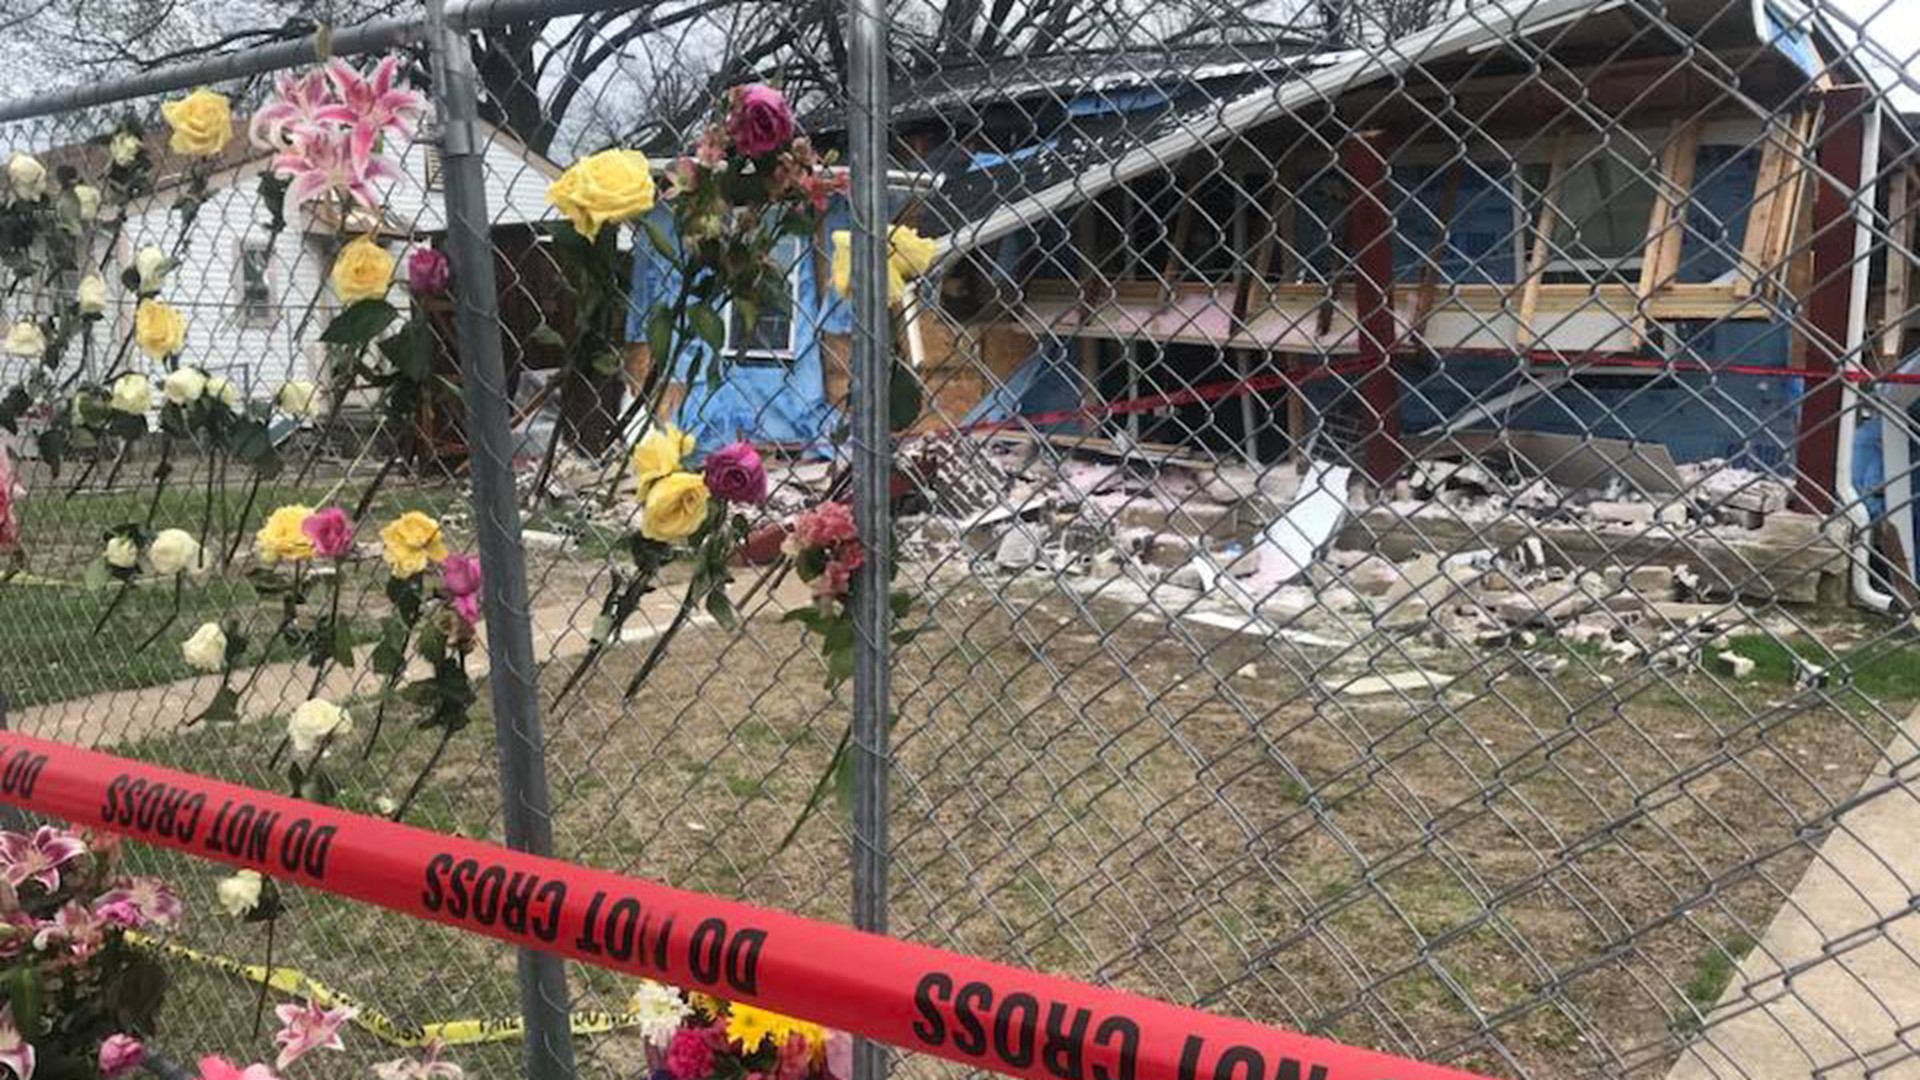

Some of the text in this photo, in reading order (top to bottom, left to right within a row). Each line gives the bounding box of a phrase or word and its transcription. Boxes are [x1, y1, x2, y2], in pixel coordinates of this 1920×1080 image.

[1, 751, 47, 799] DO
[101, 774, 337, 879] DO NOT CROSS
[423, 854, 767, 996] DO NOT CROSS
[912, 972, 1140, 1080] CROSS
